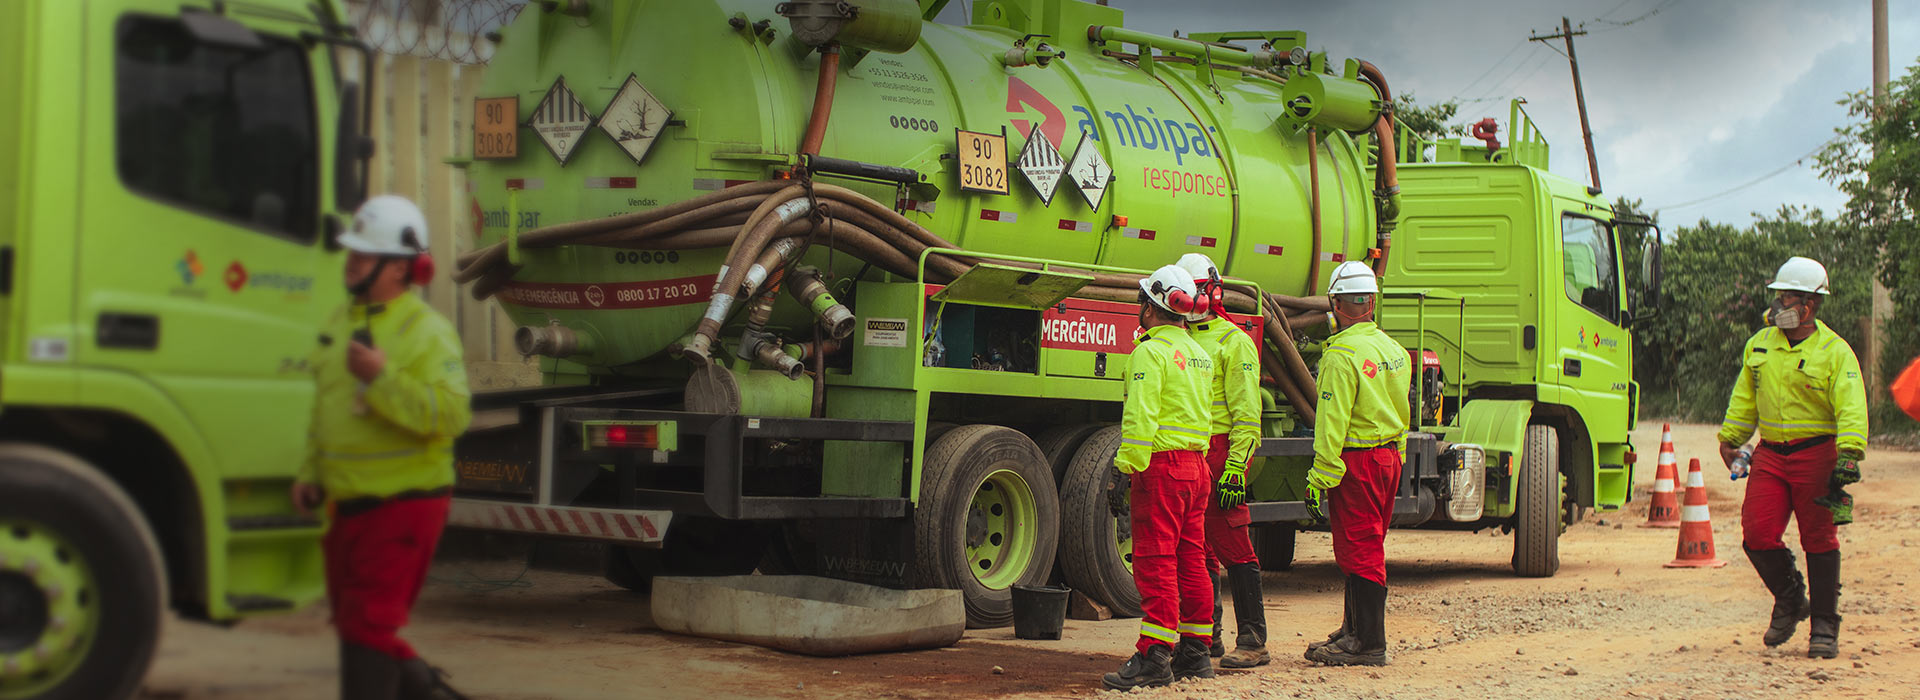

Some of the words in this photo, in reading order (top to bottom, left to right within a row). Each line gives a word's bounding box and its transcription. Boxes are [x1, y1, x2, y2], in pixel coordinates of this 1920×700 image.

[486, 103, 503, 125] 90
[478, 132, 513, 154] 3082
[559, 139, 567, 153] 9
[973, 138, 992, 160] 90
[964, 164, 1003, 189] 3082
[1143, 167, 1226, 199] response
[1042, 182, 1049, 194] 9
[627, 198, 658, 207] Vendas:
[484, 206, 541, 233] ambpar
[525, 287, 580, 304] EMERGÊNCIA
[617, 288, 644, 302] 0800
[646, 287, 662, 301] 17
[664, 286, 679, 299] 20
[681, 283, 697, 297] 20
[1041, 316, 1117, 346] MERGÊNCIA
